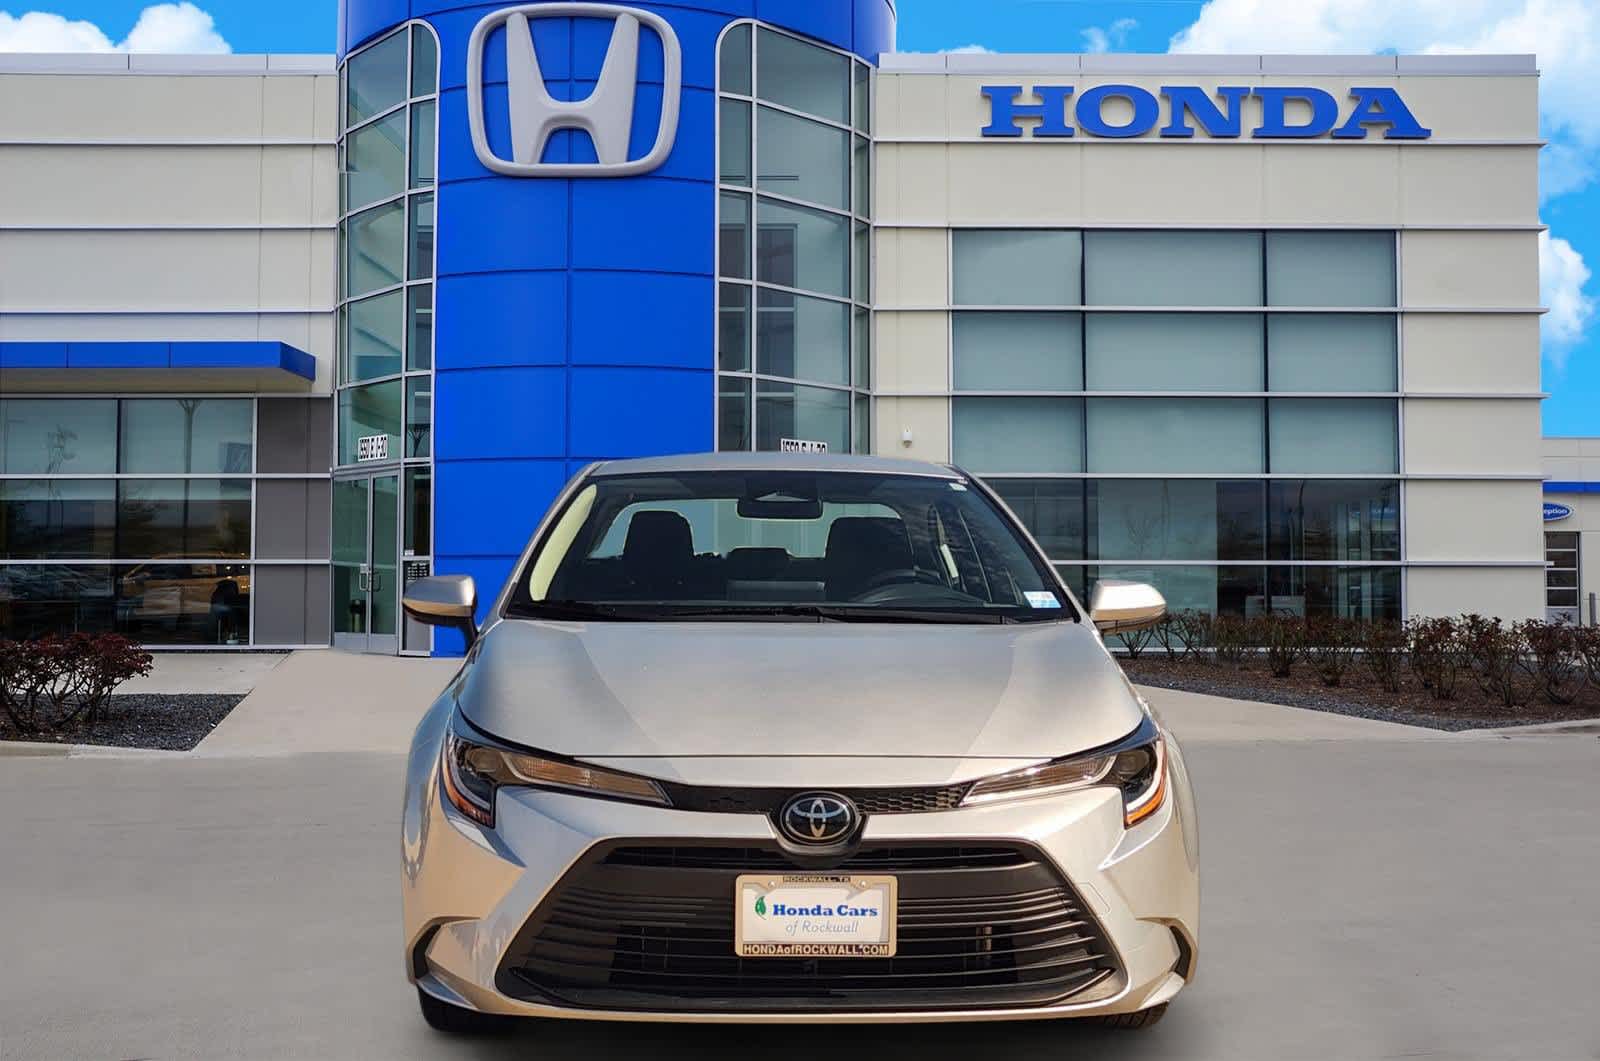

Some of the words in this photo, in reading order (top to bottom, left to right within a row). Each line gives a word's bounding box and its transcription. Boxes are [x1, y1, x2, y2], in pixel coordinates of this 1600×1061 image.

[980, 84, 1432, 138] HONDA
[1543, 507, 1568, 515] eption
[773, 904, 833, 916] Honda
[837, 904, 878, 916] Cars
[785, 921, 798, 936] of
[802, 920, 859, 933] Rockwall
[743, 944, 889, 956] HONDAofROCKWALL.COM
